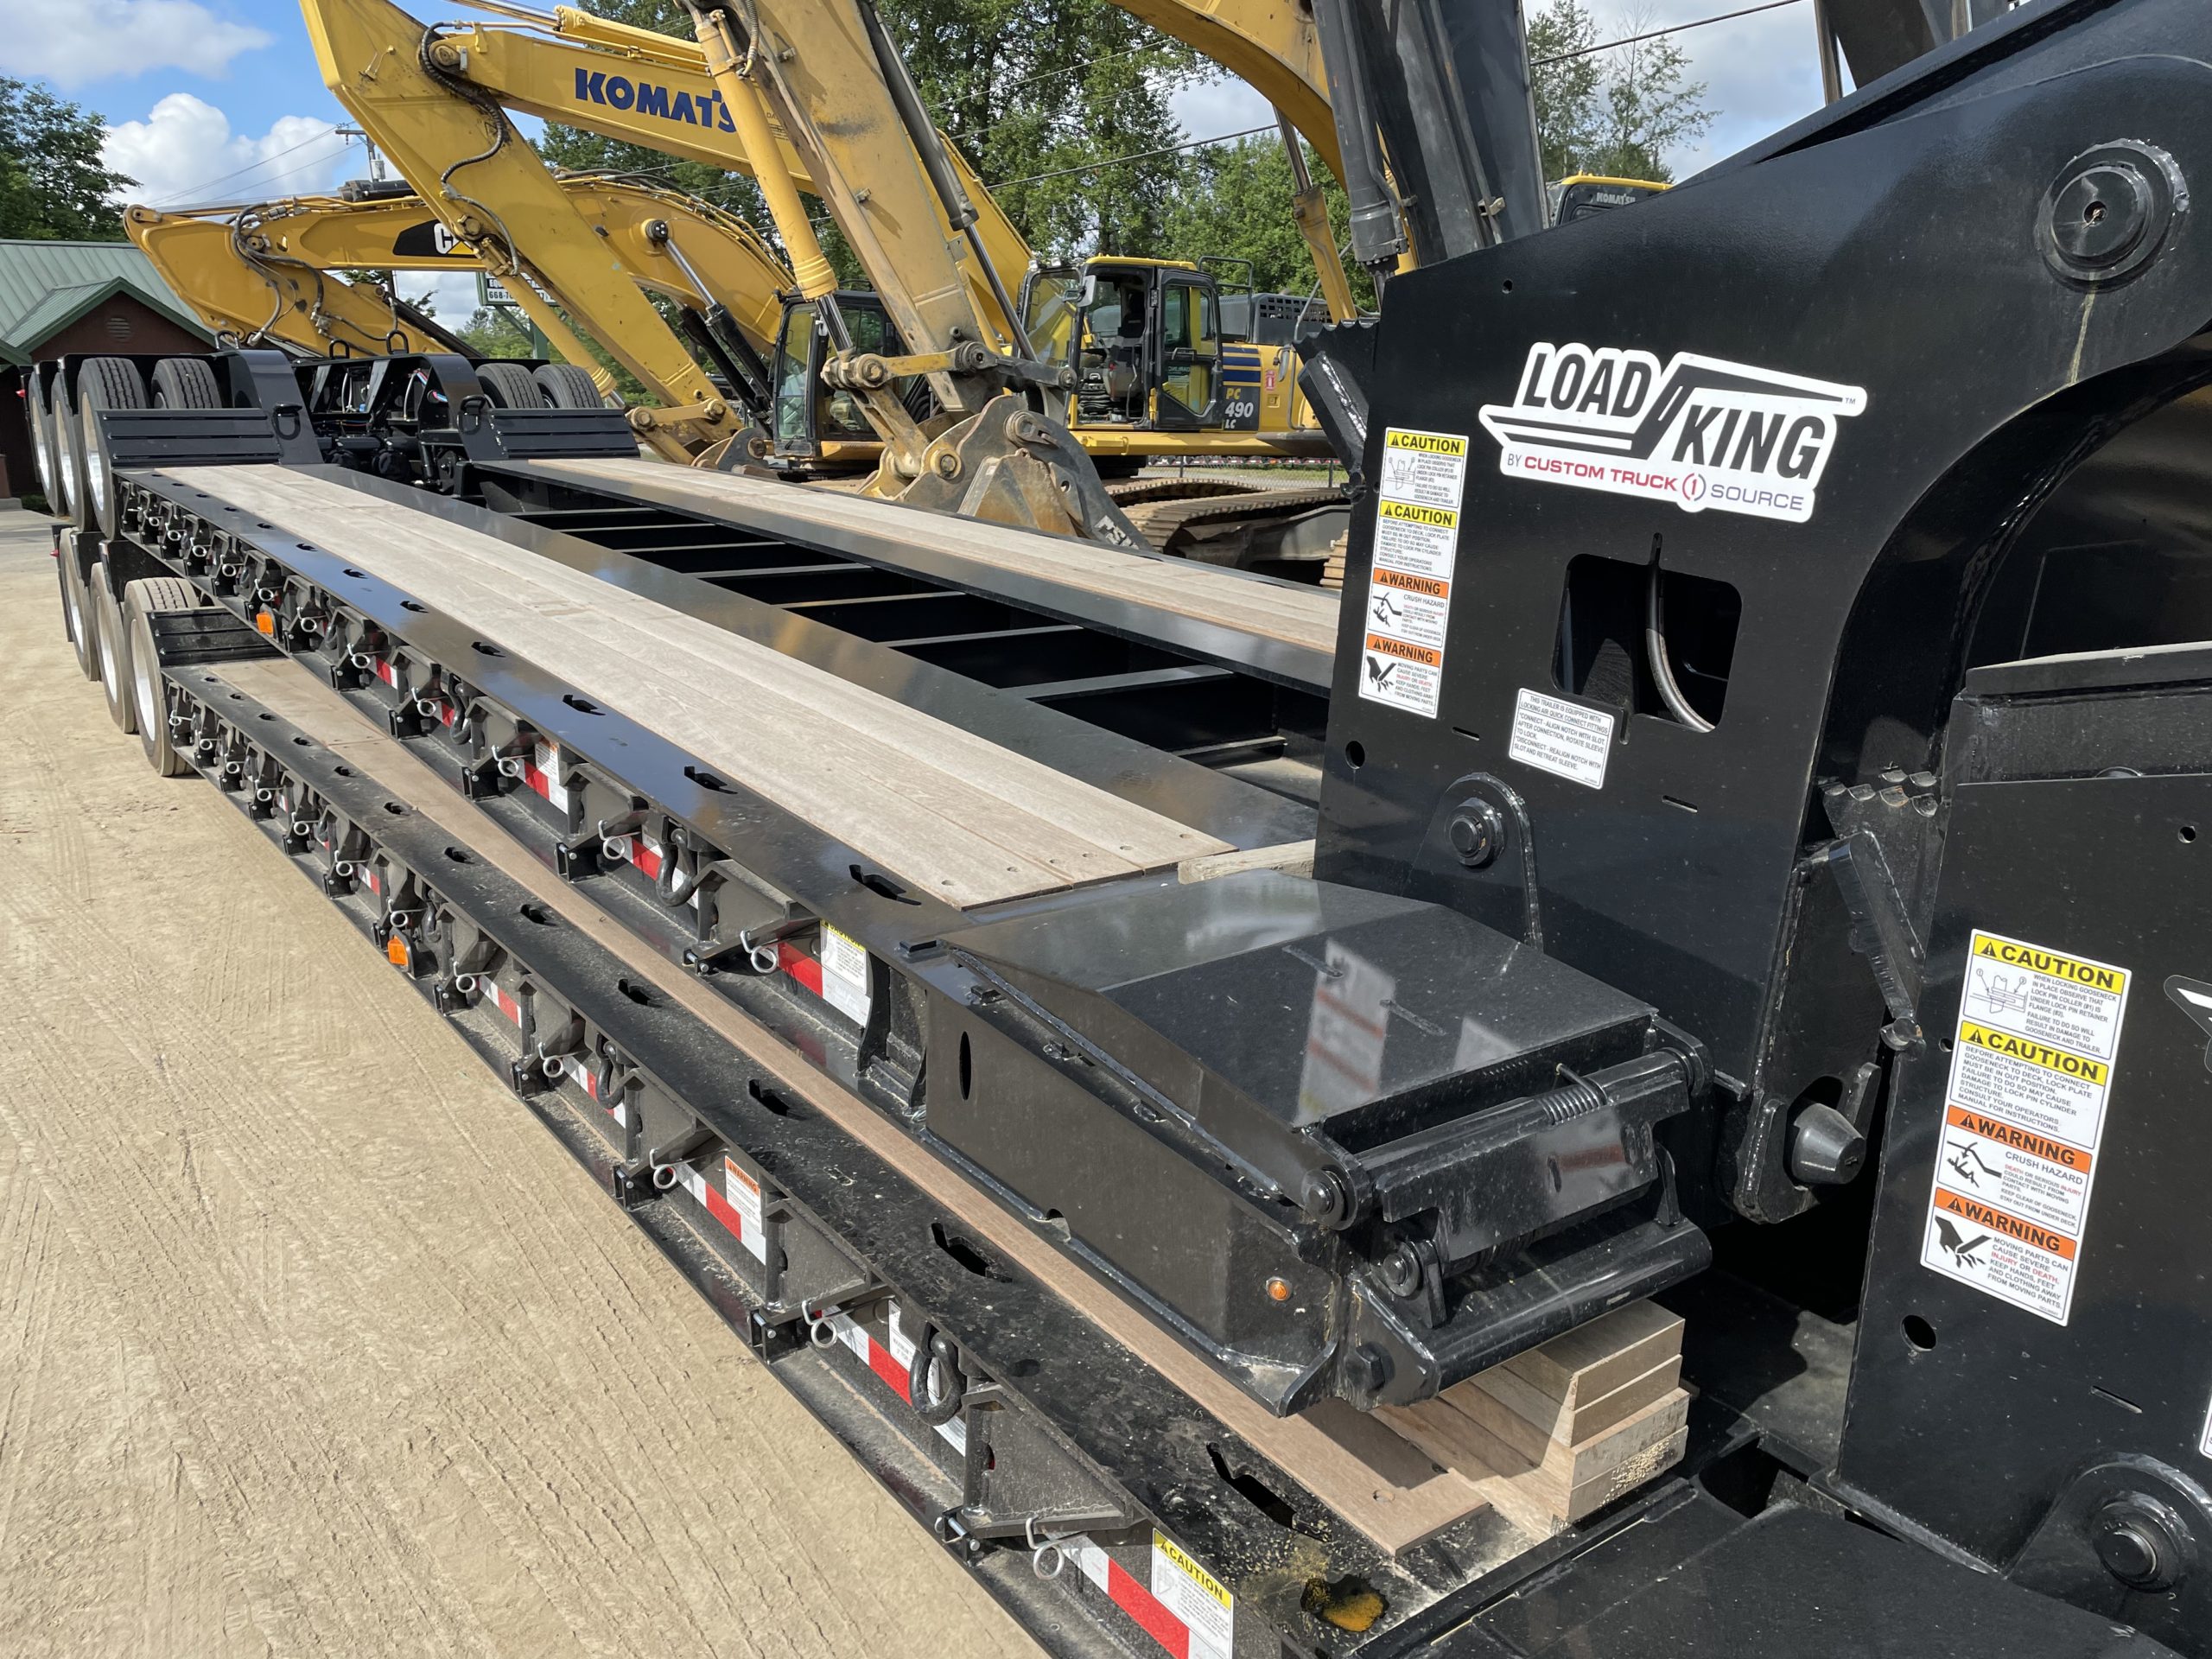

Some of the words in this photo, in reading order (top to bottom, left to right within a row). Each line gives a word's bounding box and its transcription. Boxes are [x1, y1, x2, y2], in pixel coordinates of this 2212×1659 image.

[1226, 388, 1242, 400] PC
[1522, 353, 1652, 418] LOAD
[1225, 401, 1254, 418] 490
[1225, 419, 1236, 429] LC
[1401, 435, 1459, 453] CAUTION
[1672, 404, 1827, 480] KING
[1507, 453, 1522, 467] BY
[1524, 455, 1605, 480] CUSTOM
[1610, 469, 1677, 492] TRUCK
[1711, 484, 1804, 512] SOURCE
[1394, 505, 1452, 525] CAUTION
[1389, 573, 1440, 594] WARNING
[1403, 594, 1421, 603] CRUSH
[1422, 598, 1444, 608] HAZARD
[1382, 639, 1433, 663] WARNING
[2000, 944, 2113, 988] CAUTION
[2031, 988, 2047, 997] LOCK
[2047, 992, 2058, 1001] PIN
[2058, 995, 2082, 1007] COLLER
[2033, 974, 2050, 983] WHEN
[2051, 979, 2078, 991] LOCKING
[2078, 986, 2116, 1001] GOOSENECK
[2038, 982, 2058, 993] PLACE
[2058, 988, 2088, 1001] OBSERVE
[2088, 996, 2103, 1006] THAT
[2028, 1001, 2051, 1014] FLANGE
[2029, 995, 2050, 1006] UNDER
[2050, 1001, 2067, 1011] LOCK
[2078, 1009, 2107, 1022] RETAINER
[2024, 1025, 2061, 1041] GOOSENECK
[2061, 1036, 2075, 1046] AND
[2025, 1018, 2048, 1030] RESULT
[2055, 1027, 2081, 1039] DAMAGE
[2082, 1034, 2090, 1043] TO
[2026, 1011, 2051, 1023] FAILURE
[2060, 1020, 2070, 1029] DO
[2080, 1027, 2094, 1036] WILL
[1965, 1046, 1993, 1059] BEFORE
[1994, 1055, 2041, 1075] ATTEMPTING
[2042, 1070, 2052, 1078] TO
[2053, 1073, 2090, 1090] CONNECT
[1986, 1032, 2099, 1080] CAUTION
[1962, 1058, 1982, 1070] MUST
[1983, 1065, 1994, 1074] BE
[2004, 1071, 2019, 1082] OUT
[1964, 1052, 2009, 1071] GOOSENECK
[2010, 1066, 2020, 1076] TO
[2045, 1077, 2067, 1090] LOCK
[2068, 1085, 2092, 1098] PLATE
[1961, 1065, 1992, 1080] FAILURE
[1993, 1075, 2003, 1084] TO
[2004, 1079, 2015, 1088] DO
[2016, 1083, 2027, 1092] SO
[2028, 1087, 2044, 1097] MAY
[2045, 1092, 2071, 1107] CAUSE
[1961, 1072, 1992, 1088] DAMAGE
[1993, 1083, 2003, 1091] TO
[2004, 1086, 2024, 1098] LOCK
[2025, 1093, 2038, 1103] PIN
[2039, 1098, 2077, 1116] CYLINDER
[1957, 1092, 1986, 1108] MANUAL
[1988, 1103, 2004, 1113] FOR
[1958, 1085, 1991, 1102] CONSULT
[1993, 1096, 2013, 1109] YOUR
[2014, 1104, 2059, 1124] OPERATORS
[1977, 1118, 2075, 1166] WARNING
[2005, 1150, 2039, 1170] CRUSH
[2041, 1163, 2083, 1185] HAZARD
[1963, 1202, 2061, 1252] WARNING
[1991, 1250, 2018, 1267] INJURY
[2018, 1262, 2031, 1272] OR
[1992, 1243, 2018, 1259] CAUSE
[2019, 1255, 2050, 1272] SEVERE
[1993, 1236, 2024, 1254] MOVING
[2024, 1249, 2050, 1264] PARTS
[2050, 1259, 2069, 1271] CAN
[1986, 1272, 2007, 1287] FROM
[2008, 1281, 2036, 1298] MOVING
[1988, 1265, 2004, 1277] AND
[2004, 1271, 2040, 1292] CLOTHING
[2041, 1287, 2061, 1300] AWAY
[1989, 1257, 2008, 1271] KEEP
[2037, 1277, 2055, 1291] FEET
[1170, 1548, 1223, 1600] CAUTION
